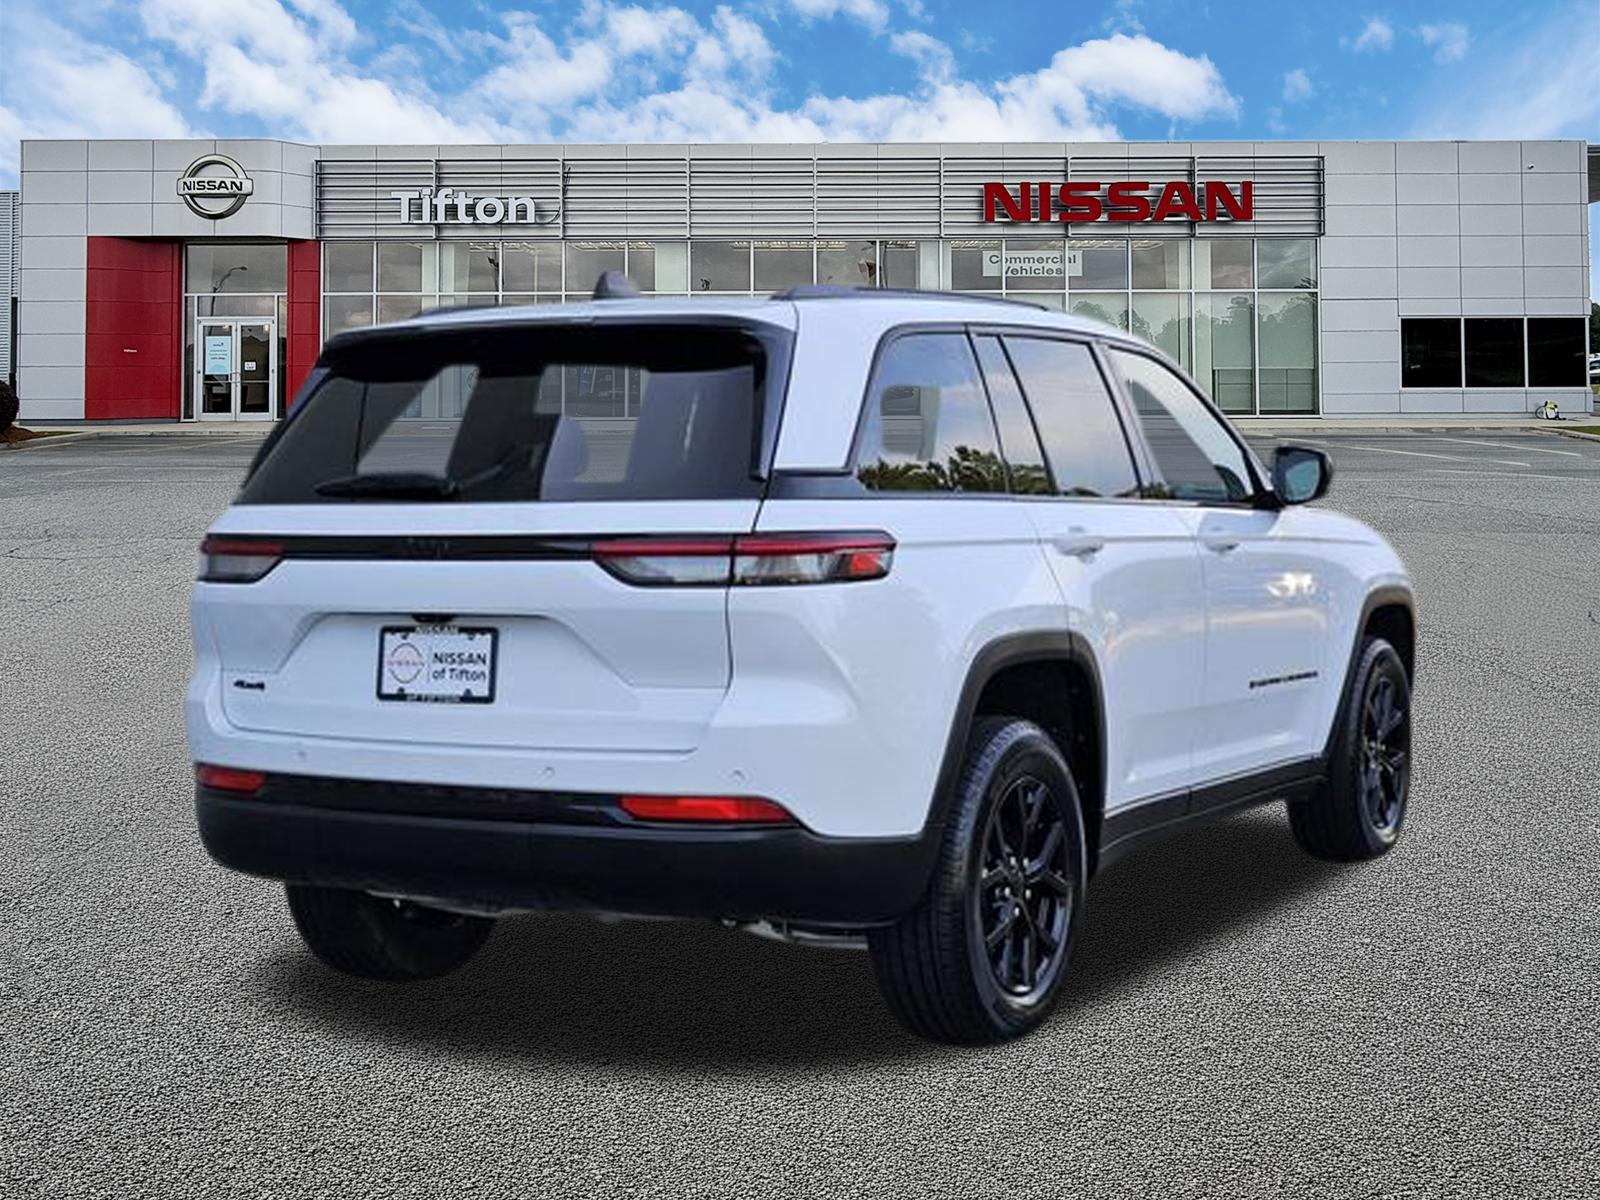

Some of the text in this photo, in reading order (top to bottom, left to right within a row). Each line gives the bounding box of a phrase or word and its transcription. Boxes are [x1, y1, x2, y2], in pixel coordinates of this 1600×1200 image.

[183, 181, 243, 191] NISSAN
[391, 187, 536, 224] Tifton
[983, 181, 1254, 223] NISSAN
[432, 652, 487, 666] NISSAN
[432, 668, 487, 682] of Tifton
